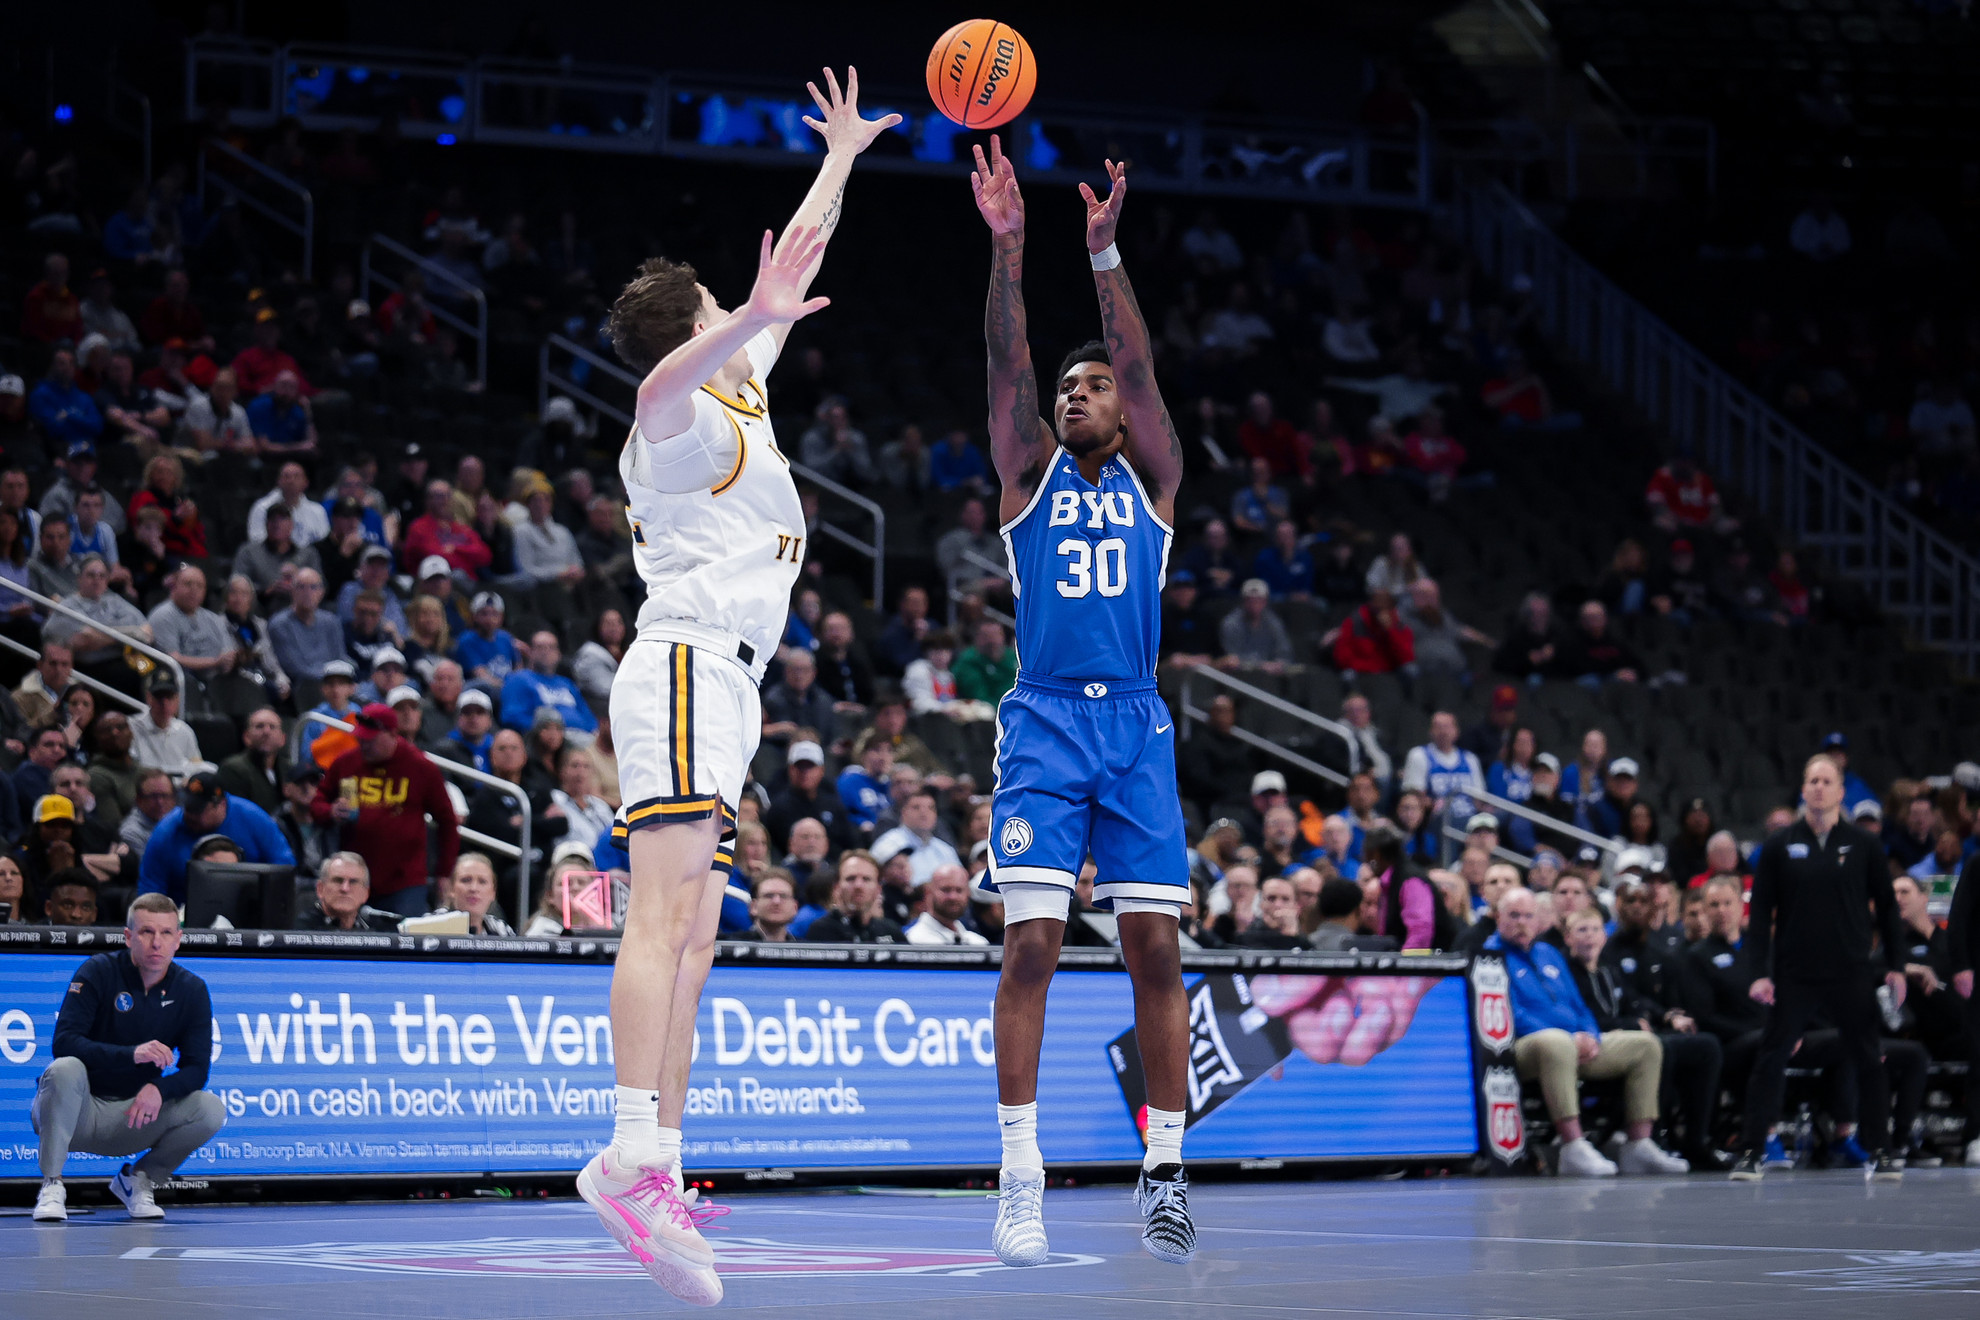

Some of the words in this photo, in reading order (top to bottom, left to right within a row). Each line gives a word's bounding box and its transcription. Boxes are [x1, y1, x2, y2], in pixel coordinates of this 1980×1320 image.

[976, 38, 1016, 107] Wilson
[1049, 490, 1136, 529] BYU
[1055, 537, 1128, 599] 30
[1090, 684, 1103, 697] Y
[10, 932, 41, 943] PARTNER
[105, 933, 126, 944] OFFIC
[190, 934, 218, 945] PARTNER
[283, 934, 312, 946] OFFICIAL
[364, 936, 391, 948] PARTNER
[447, 939, 475, 950] OFFICIAL
[524, 940, 550, 952] PARTNER
[236, 992, 377, 1065] with
[389, 993, 497, 1066] the
[712, 996, 863, 1067] Debit
[308, 1077, 382, 1117] cash
[388, 1077, 466, 1117] back
[469, 1077, 538, 1117] with
[739, 1076, 866, 1116] Rewards.
[217, 1143, 241, 1159] The
[242, 1143, 294, 1162] Bancorp
[356, 1142, 397, 1158] Venmo
[397, 1141, 433, 1158] Stash
[436, 1142, 470, 1157] terms
[471, 1141, 493, 1157] and
[493, 1140, 550, 1157] exclusions
